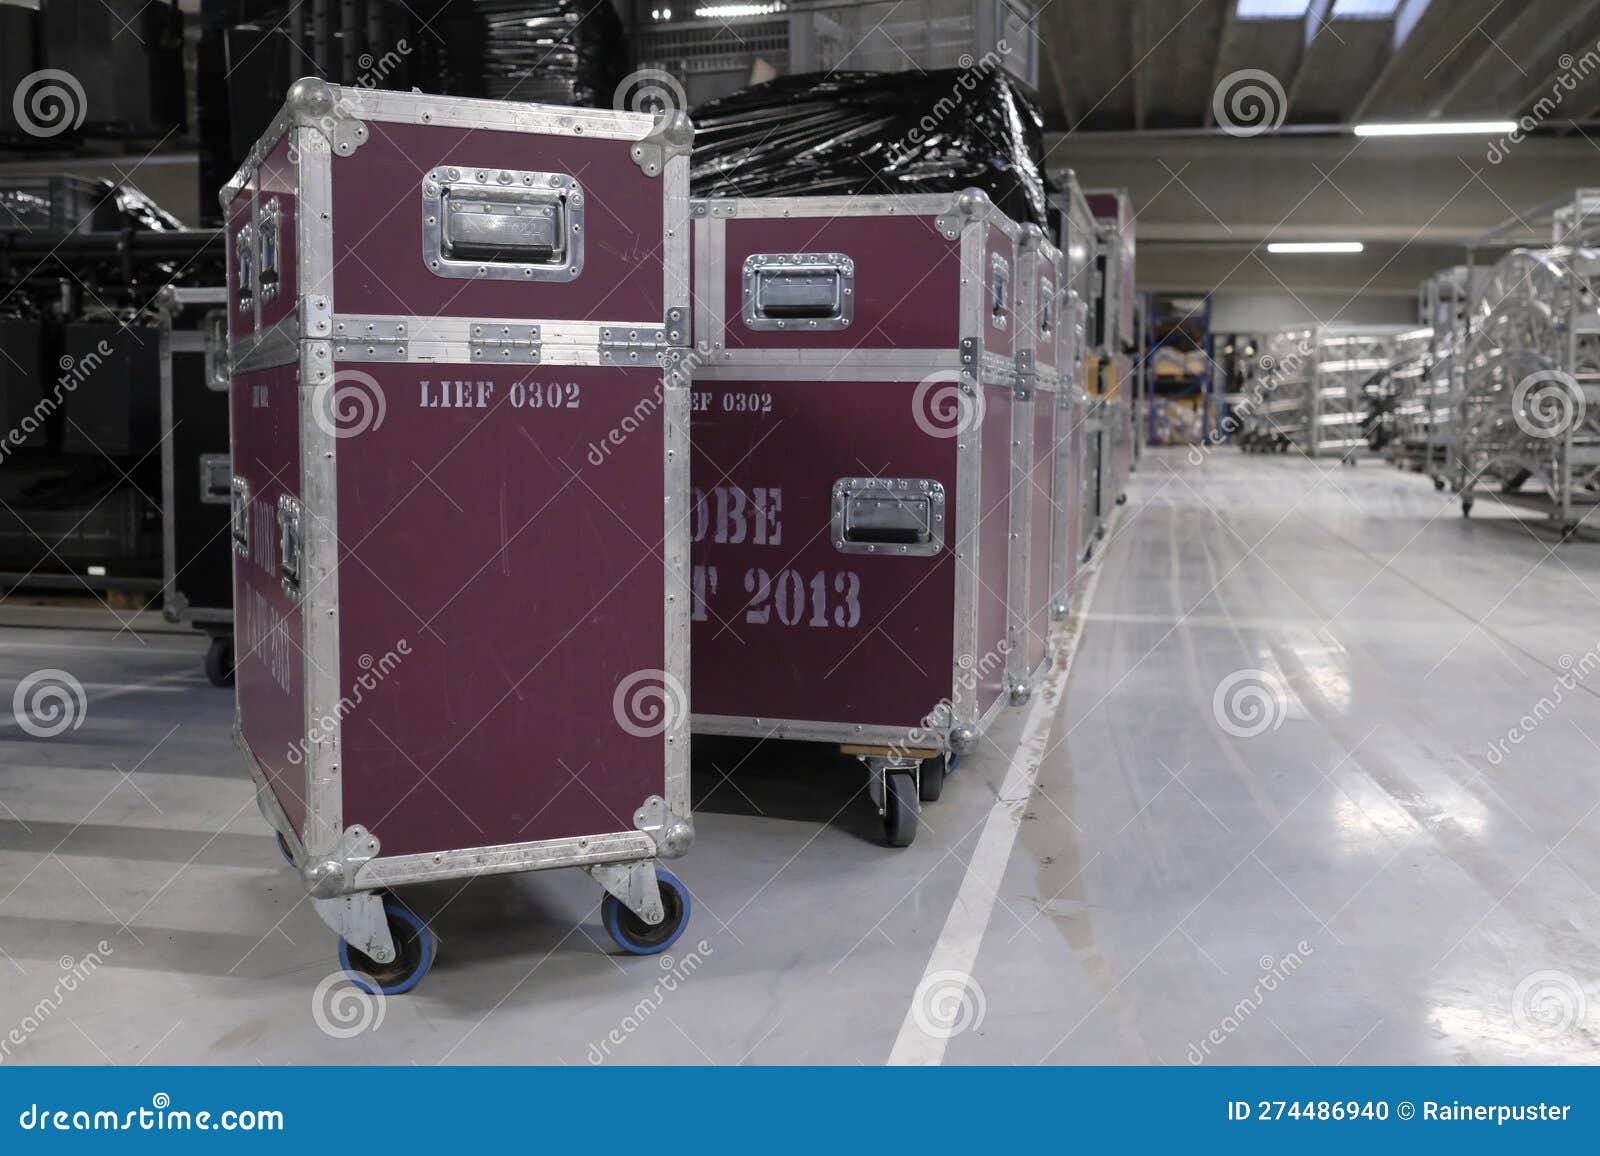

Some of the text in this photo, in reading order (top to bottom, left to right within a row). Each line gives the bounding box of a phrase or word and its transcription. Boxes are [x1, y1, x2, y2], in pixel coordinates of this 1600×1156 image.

[419, 380, 580, 409] LIEF 0302
[723, 393, 773, 412] 0302
[744, 568, 861, 628] 2013
